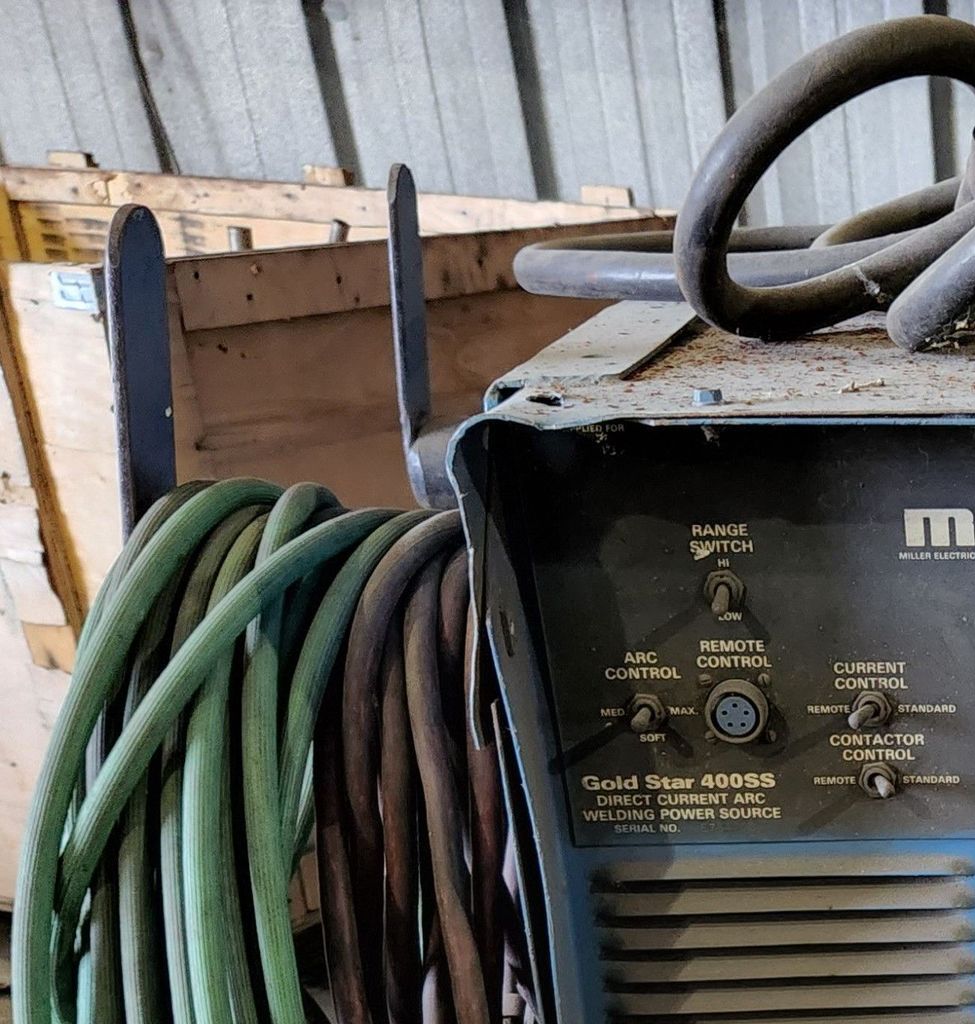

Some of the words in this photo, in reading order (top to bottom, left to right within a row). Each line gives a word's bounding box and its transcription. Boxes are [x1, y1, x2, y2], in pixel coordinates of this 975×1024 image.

[692, 524, 748, 536] RANGE
[690, 540, 753, 553] SWITCH
[899, 552, 931, 560] MILLER
[934, 552, 975, 560] ELECTRIC
[718, 558, 729, 567] HI
[700, 640, 765, 652] REMOTE
[624, 652, 658, 664] ARC
[696, 655, 772, 668] CONTROL
[605, 667, 681, 680] CONTROL
[834, 662, 906, 674] CURRENT
[835, 677, 908, 689] CONTROL
[670, 706, 698, 715] MAX.
[807, 705, 850, 713] REMOTE
[898, 704, 956, 713] STANDARD
[640, 734, 666, 742] SOFT
[830, 734, 924, 746] CONTACTOR
[843, 749, 915, 761] CONTROL
[581, 775, 638, 790] Gold
[645, 774, 695, 790] Star
[701, 772, 776, 789] 400SS
[814, 776, 856, 785] REMOTE
[903, 775, 960, 784] STANDARD
[596, 794, 652, 806] DIRECT
[657, 793, 728, 805] CURRENT
[734, 792, 766, 804] ARC
[583, 809, 655, 822] WELDING
[660, 808, 715, 820] POWER
[719, 807, 781, 819] SOURCE
[614, 824, 656, 833] SERIAL
[660, 824, 680, 833] NO.
